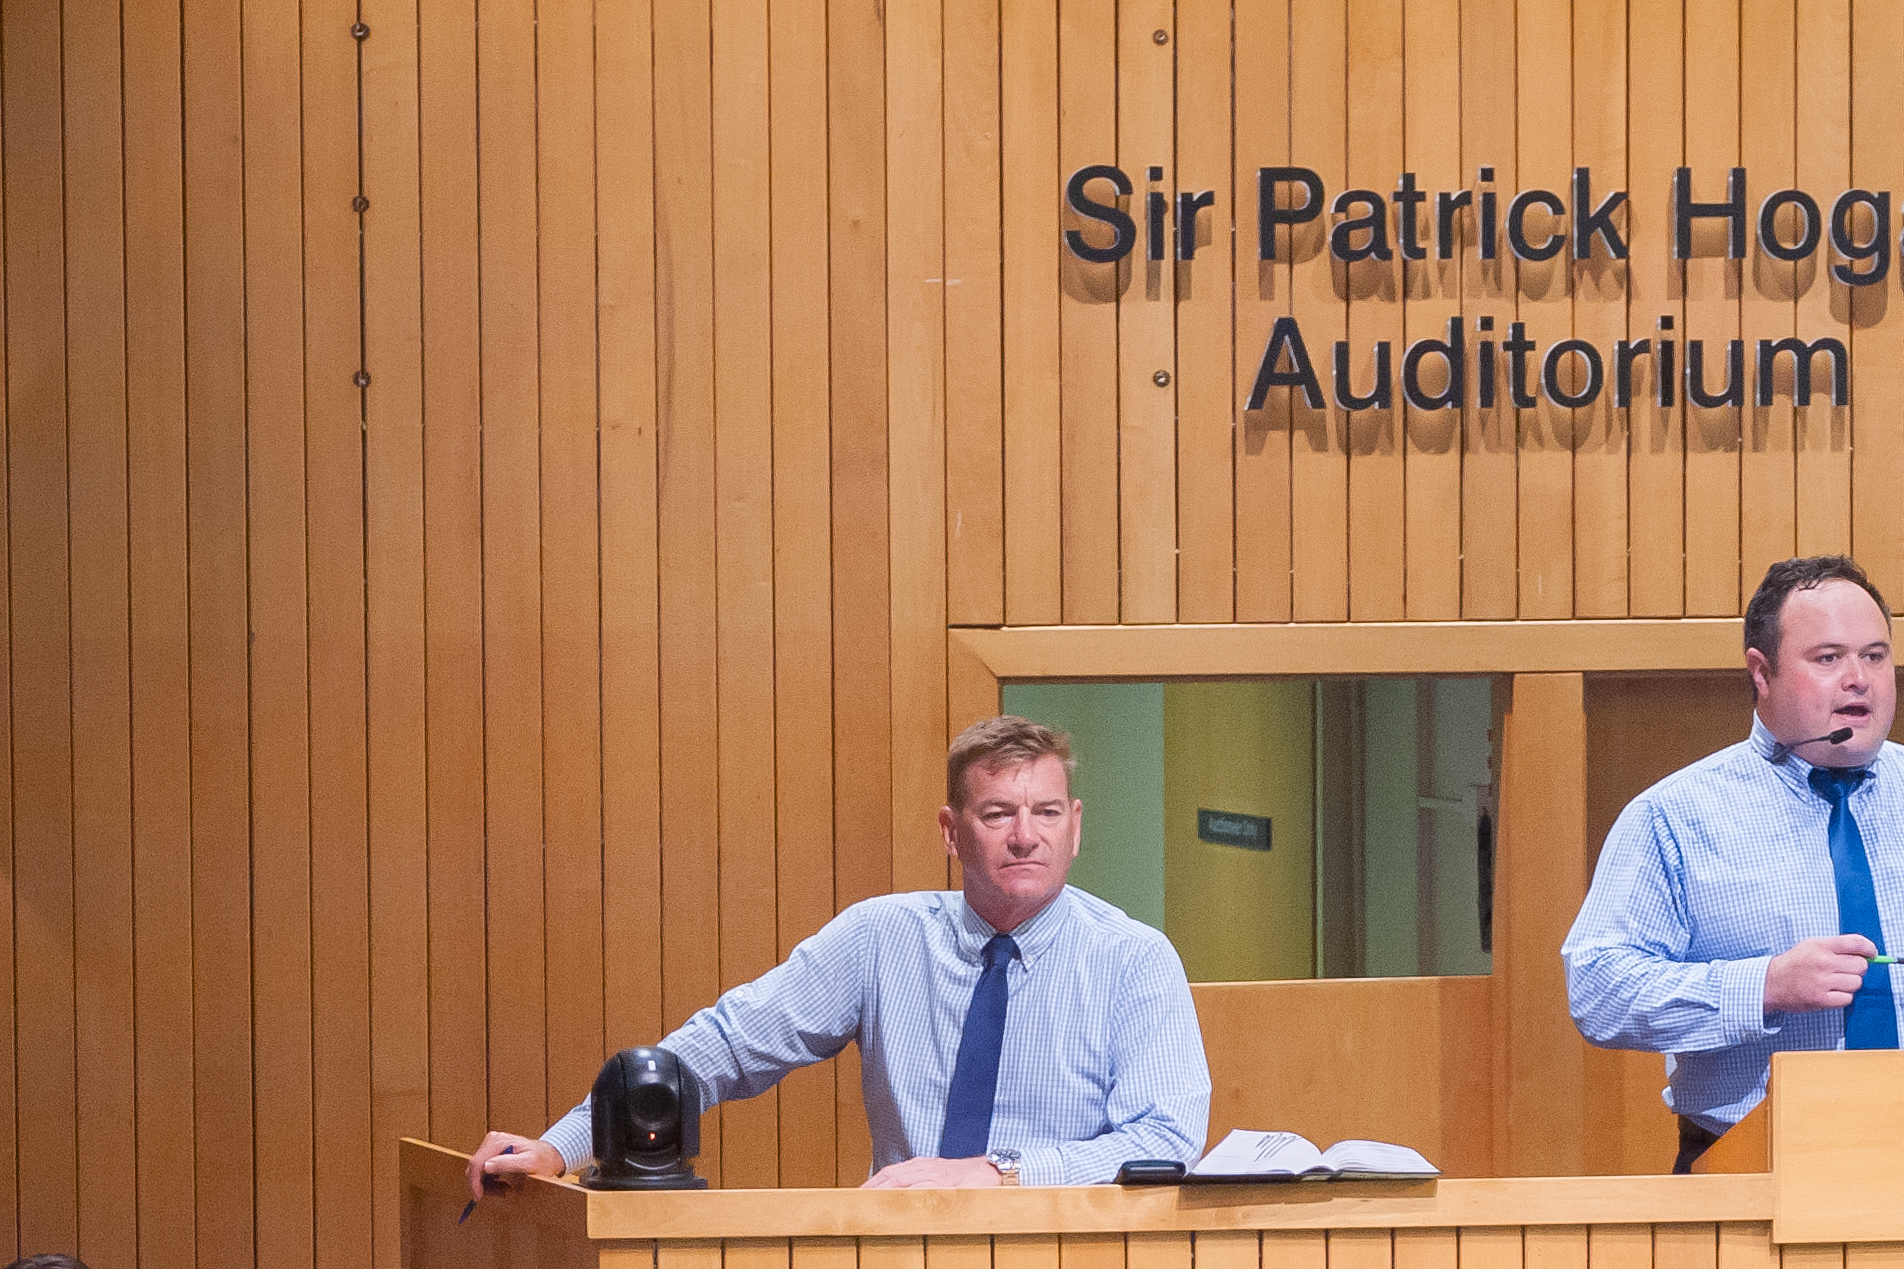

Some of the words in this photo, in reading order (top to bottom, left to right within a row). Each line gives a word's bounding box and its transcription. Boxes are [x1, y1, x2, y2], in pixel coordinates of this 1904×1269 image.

[1063, 165, 1215, 264] Sir
[1257, 165, 1630, 263] Patrick
[1245, 315, 1850, 413] Auditorium
